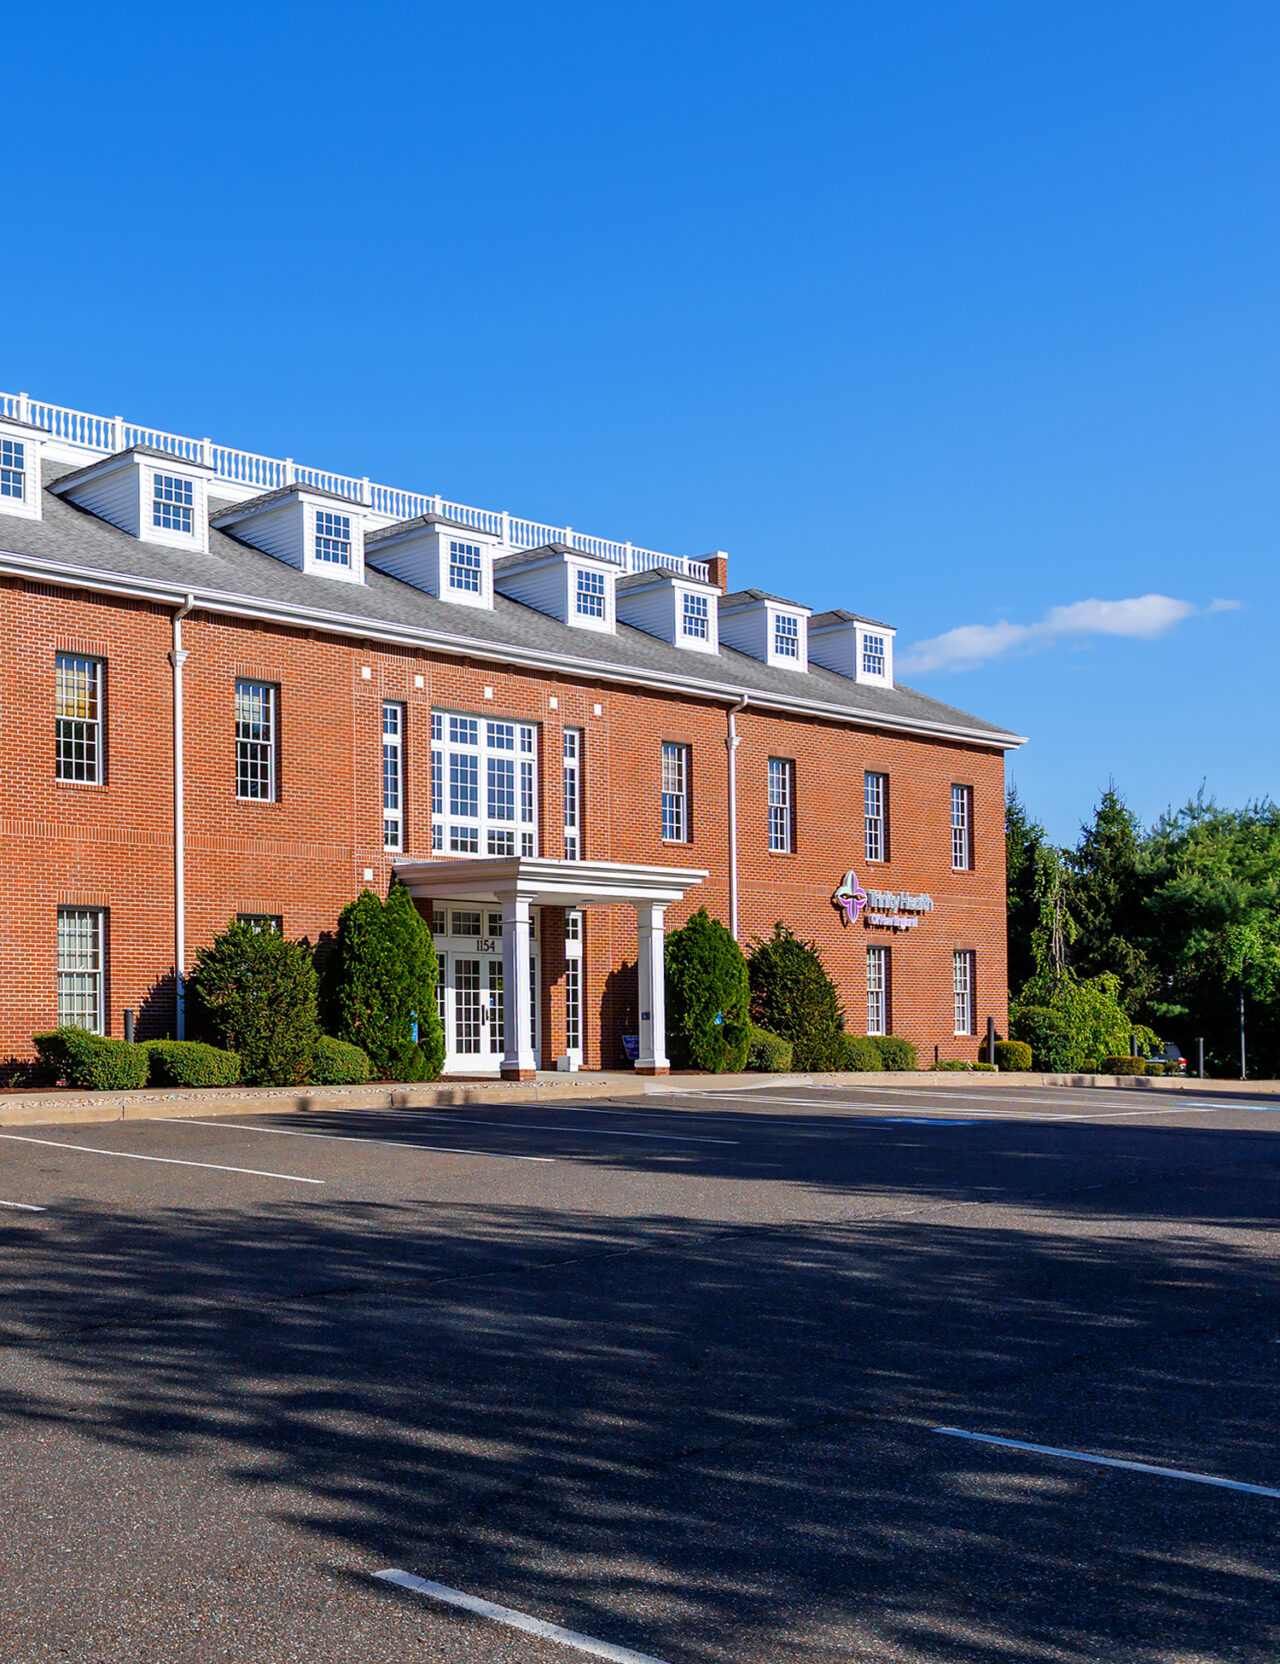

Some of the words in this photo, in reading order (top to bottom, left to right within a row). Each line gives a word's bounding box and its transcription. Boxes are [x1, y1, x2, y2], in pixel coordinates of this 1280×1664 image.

[868, 889, 900, 913] Trinity
[900, 892, 933, 911] Health
[476, 940, 496, 952] 1154
